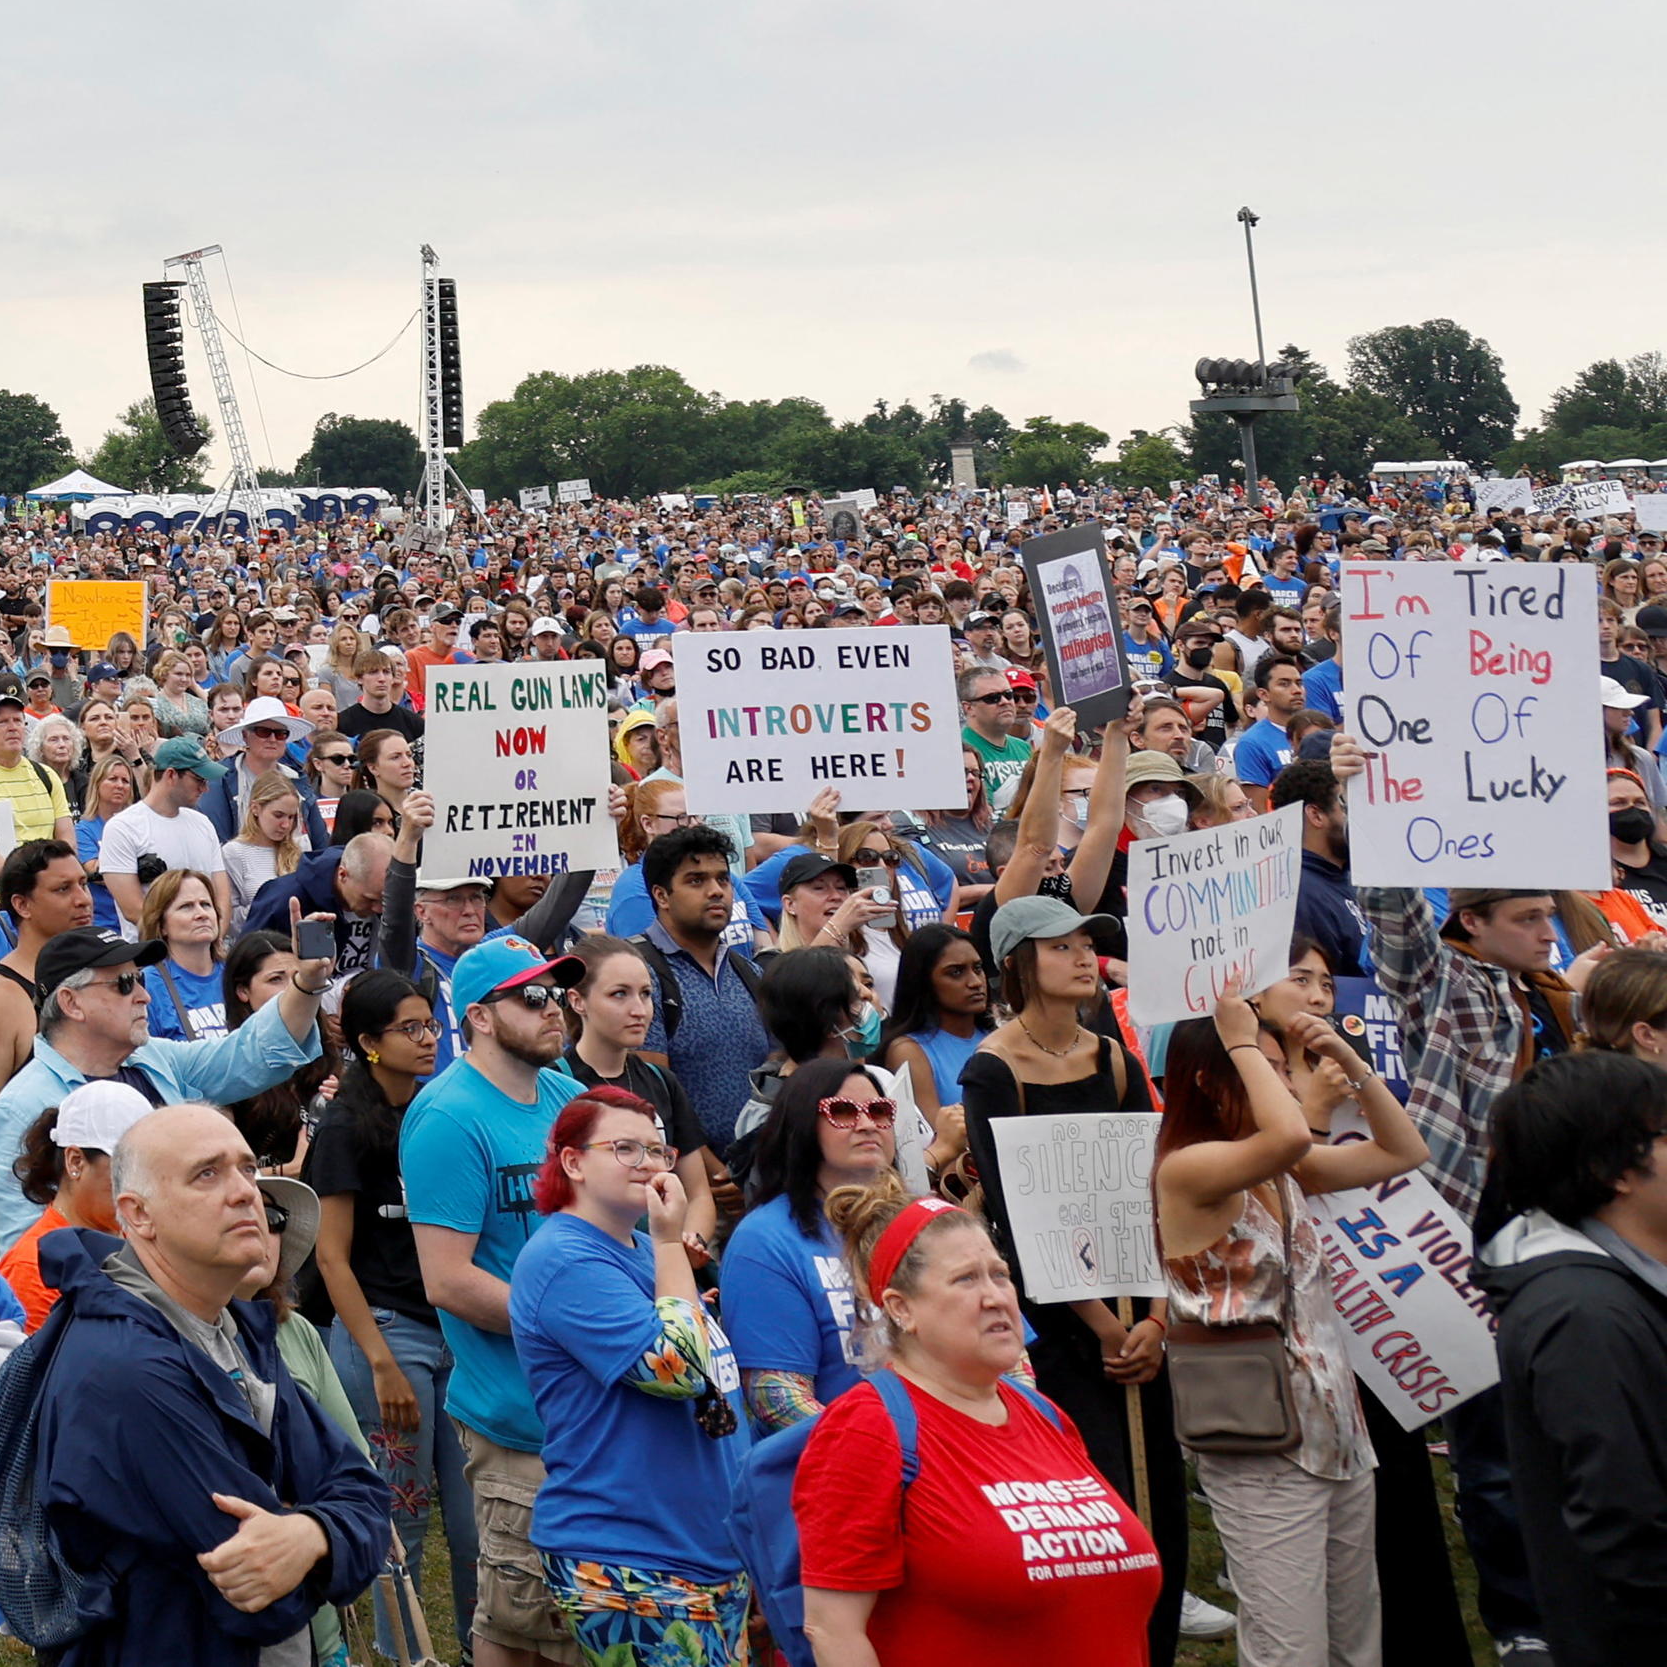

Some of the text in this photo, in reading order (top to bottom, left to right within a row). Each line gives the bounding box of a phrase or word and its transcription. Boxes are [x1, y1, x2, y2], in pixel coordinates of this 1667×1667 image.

[63, 586, 122, 604] Nowhere
[1346, 568, 1565, 620] I'm Tired
[81, 610, 99, 621] Is
[706, 647, 741, 673] SO
[838, 645, 910, 668] EVEN
[1369, 630, 1553, 684] Of Being
[435, 672, 606, 713] REAL GUN LAWS
[707, 702, 931, 738] INTROVERTS
[1357, 692, 1539, 747] One Of
[496, 725, 546, 758] NOW
[515, 769, 538, 790] OR
[726, 759, 784, 784] ARE
[1363, 751, 1567, 806] The Lucky
[446, 798, 596, 833] RETIREMENT
[512, 833, 536, 852] IN
[1145, 830, 1249, 881] Invest in
[1407, 817, 1495, 863] Ones
[469, 852, 569, 877] NOVEMBER
[1191, 926, 1248, 961] not in
[1052, 1122, 1081, 1141] no
[1018, 1138, 1149, 1195] SILENC
[1059, 1194, 1097, 1226] end
[1035, 1225, 1165, 1289] VIOLEN
[1336, 1206, 1426, 1298] IS A
[1371, 1329, 1460, 1414] CRISIS
[980, 1480, 1073, 1507] MOMS
[999, 1500, 1122, 1533] DEMAND
[1021, 1527, 1128, 1561] ACTION
[1027, 1553, 1159, 1582] FOR GUN SENSE IN AMERICA
